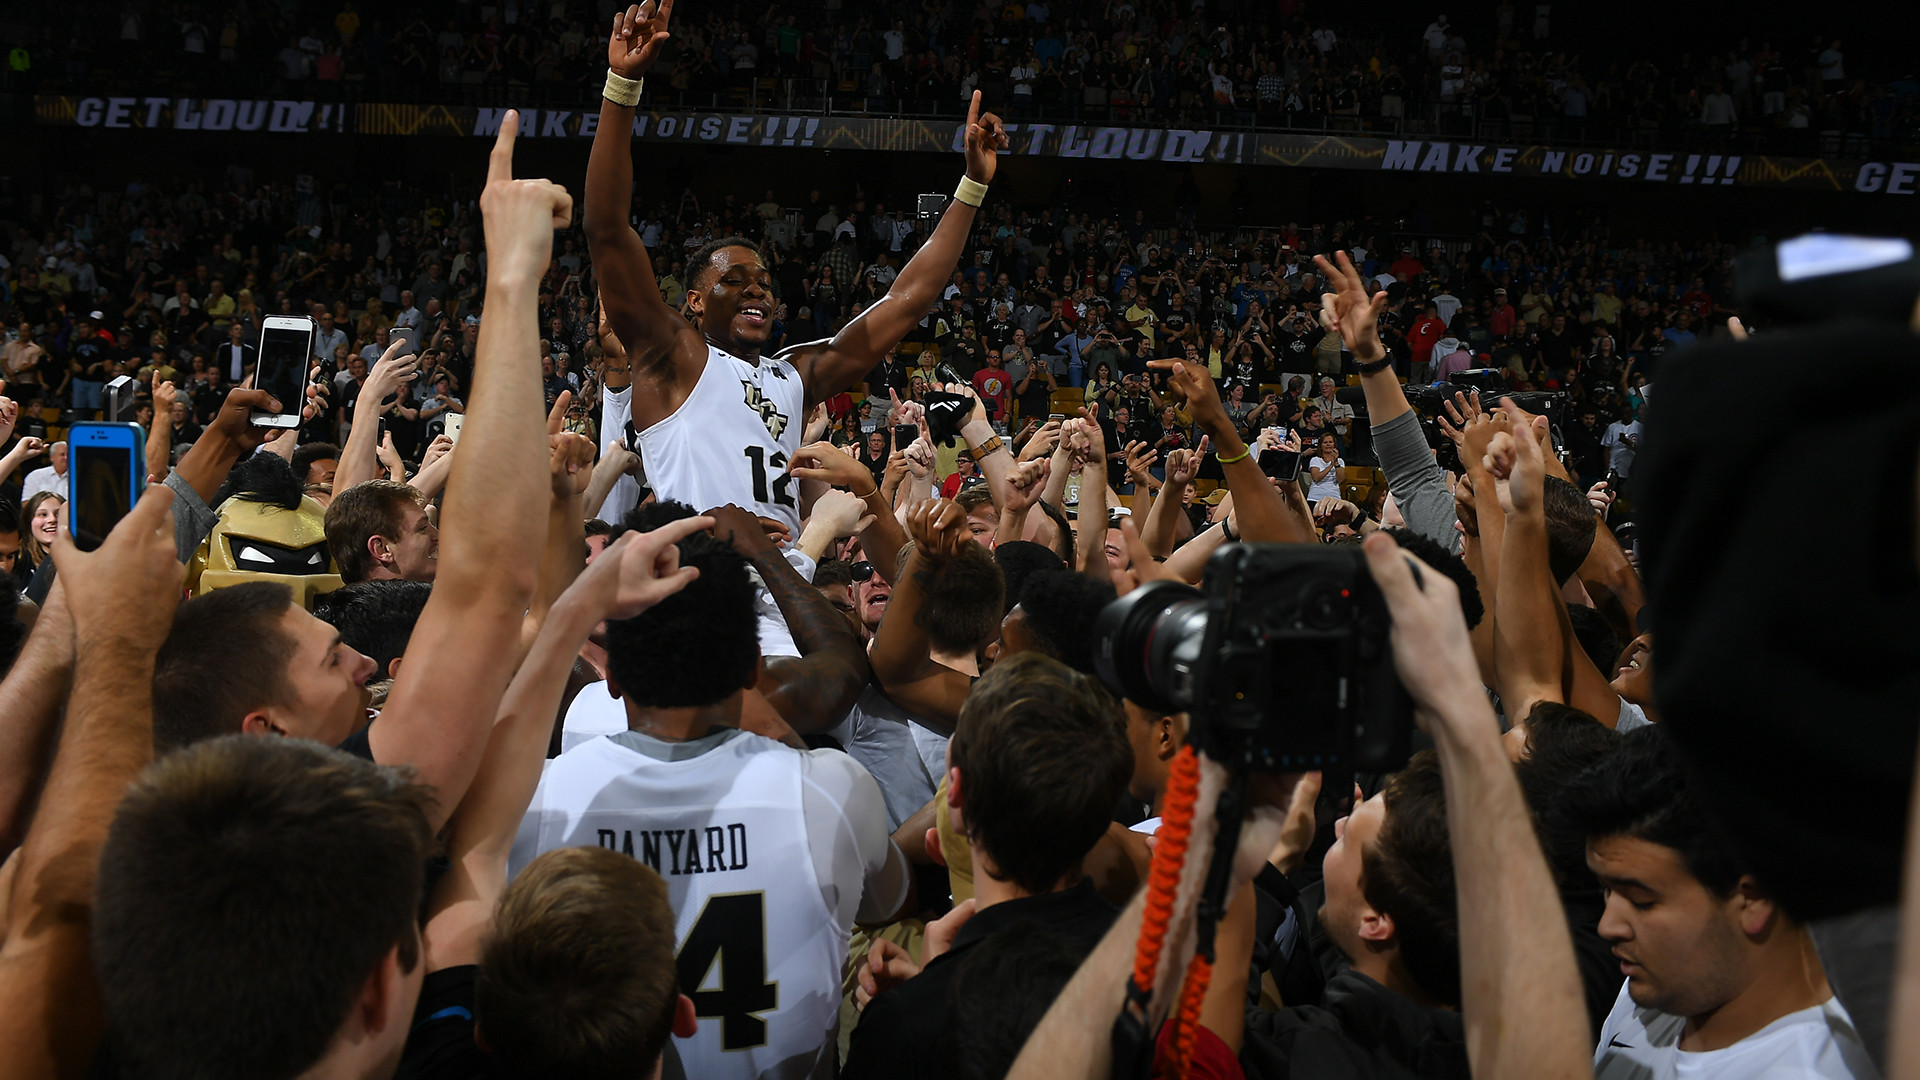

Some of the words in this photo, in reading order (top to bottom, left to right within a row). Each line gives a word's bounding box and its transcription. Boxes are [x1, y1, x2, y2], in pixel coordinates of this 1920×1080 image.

[76, 96, 170, 128] GET
[473, 107, 600, 138] MAKE
[631, 114, 820, 147] NOISE!!!
[1381, 140, 1518, 173] MAKE
[1540, 151, 1742, 185] NOISE!!!
[741, 380, 788, 442] UCF
[744, 446, 795, 508] 12
[674, 890, 779, 1052] 4
